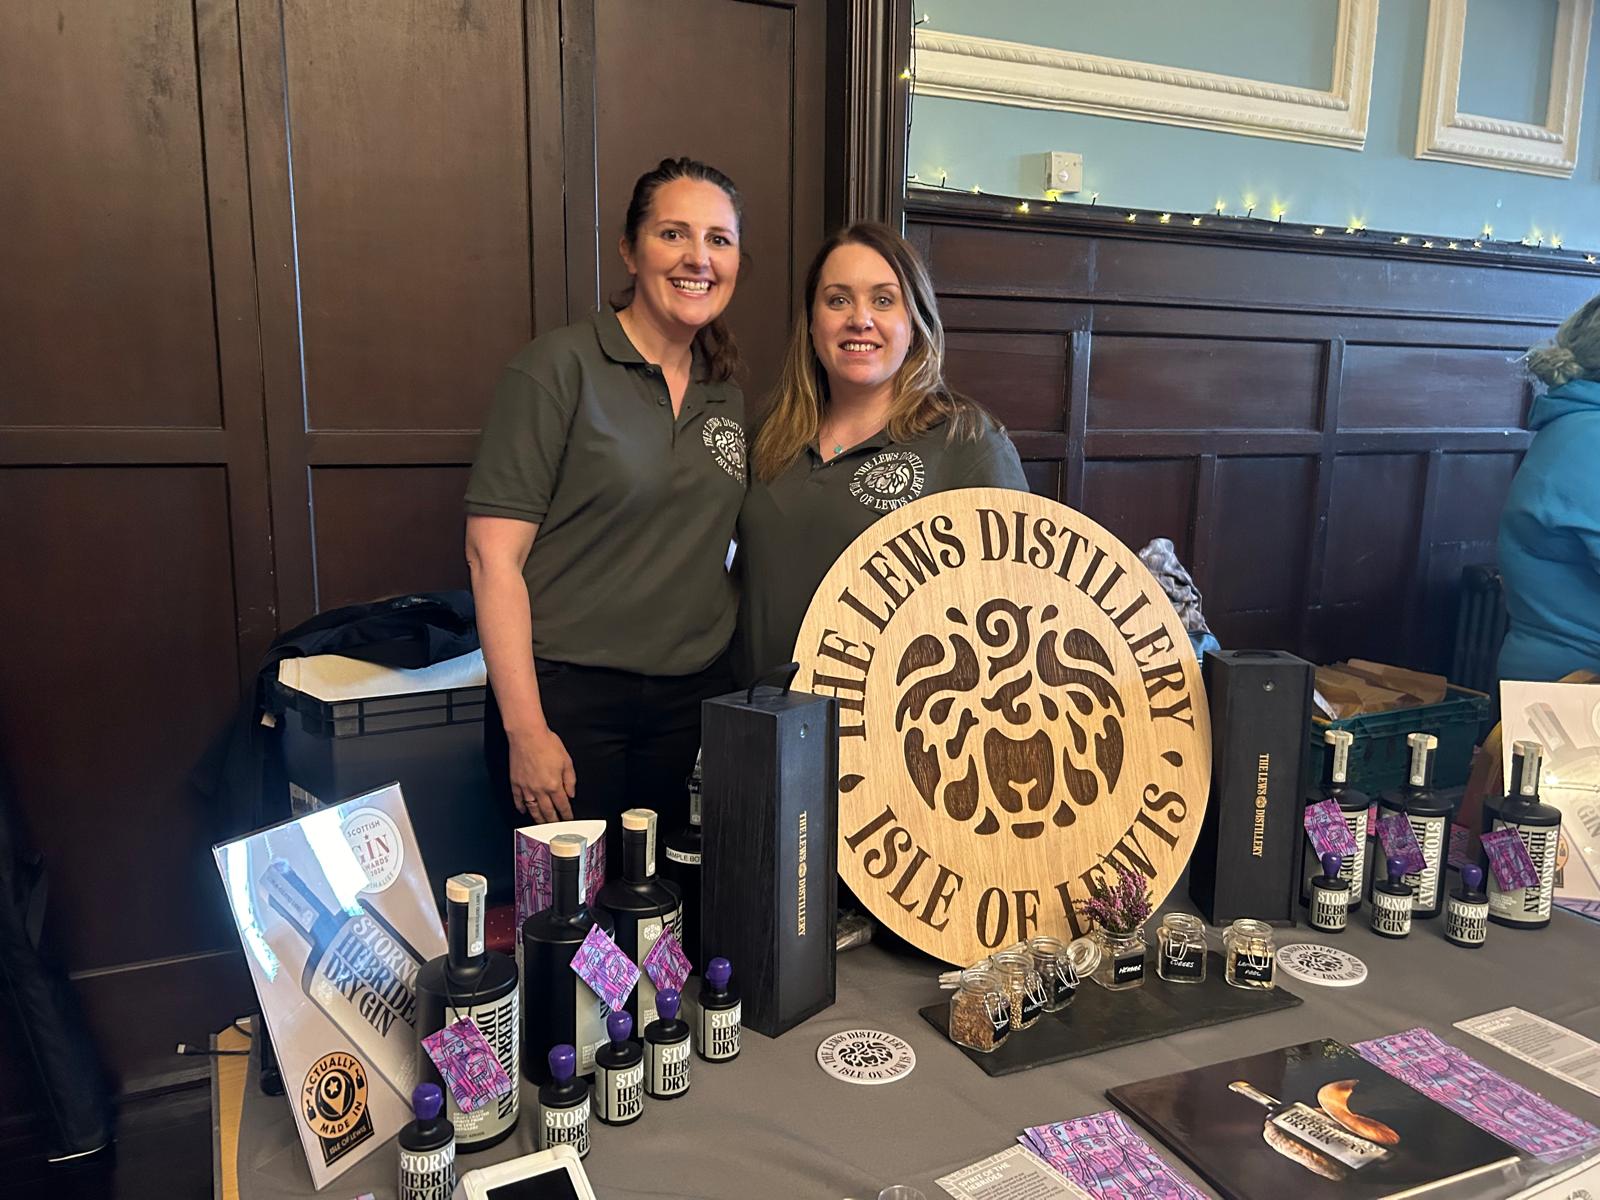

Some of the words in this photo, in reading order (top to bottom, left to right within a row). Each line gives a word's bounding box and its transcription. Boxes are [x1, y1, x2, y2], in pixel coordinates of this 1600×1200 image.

[854, 461, 874, 476] THE
[872, 452, 900, 466] LEWS
[859, 493, 875, 506] OF
[838, 514, 967, 635] LEWS
[976, 508, 1196, 732] DISTILLERY
[1258, 753, 1269, 772] THE
[1257, 772, 1268, 796] LEWS
[347, 820, 380, 838] SCOTTISH
[1252, 809, 1266, 858] DISTILLERY
[844, 804, 965, 934] ISLE
[976, 887, 1041, 949] OF
[1419, 821, 1441, 908] STORNOWAY
[1538, 830, 1558, 917] STORNOWAY
[1317, 914, 1338, 926] DRY
[1383, 920, 1404, 932] GIN
[359, 991, 398, 1037] GIN
[712, 1038, 736, 1055] DRY
[305, 1056, 356, 1096] ACTUALLY
[662, 1073, 687, 1091] DRY
[320, 1119, 350, 1135] MADE
[352, 1101, 363, 1117] IN
